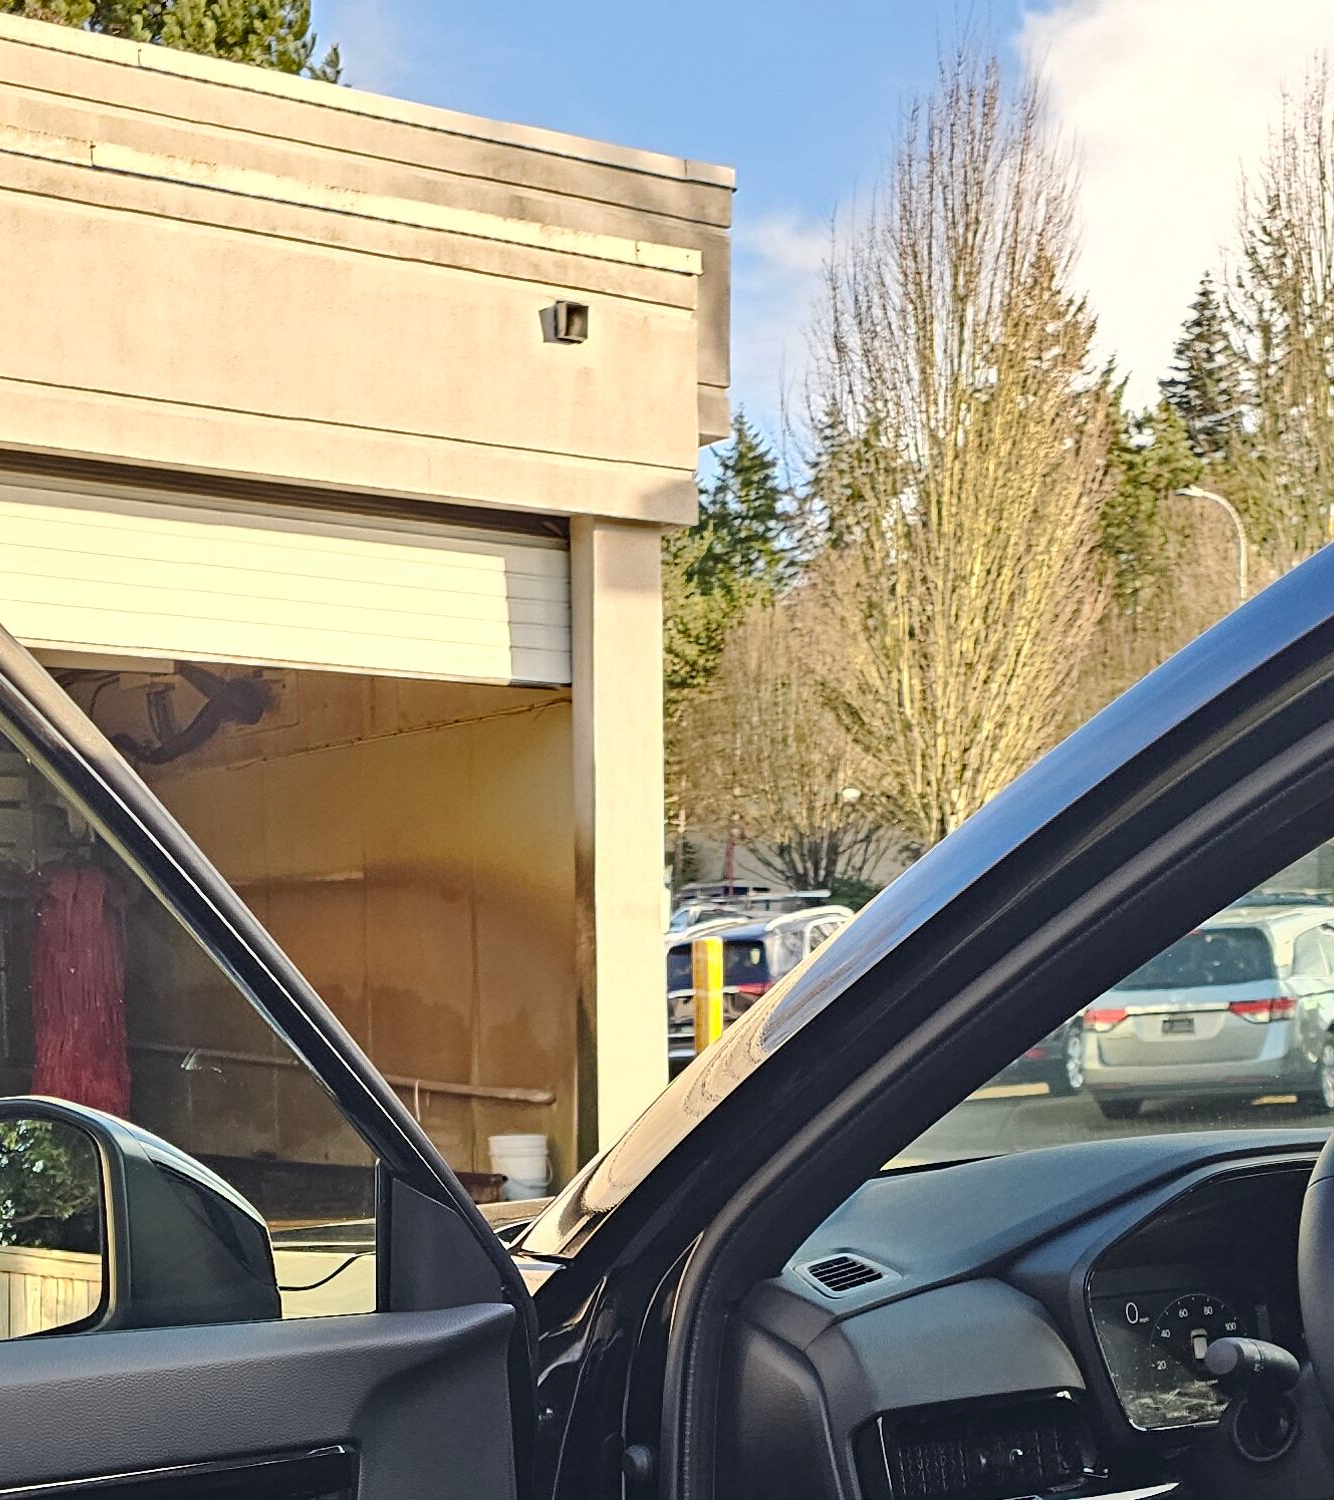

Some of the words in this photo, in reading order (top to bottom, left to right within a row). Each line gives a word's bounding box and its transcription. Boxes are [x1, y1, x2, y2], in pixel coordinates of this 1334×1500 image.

[1125, 1302, 1139, 1324] 0
[1178, 1308, 1189, 1318] 60
[1203, 1306, 1214, 1315] 80
[1224, 1322, 1237, 1331] 100
[1160, 1329, 1171, 1338] 40
[1156, 1360, 1167, 1371] 20
